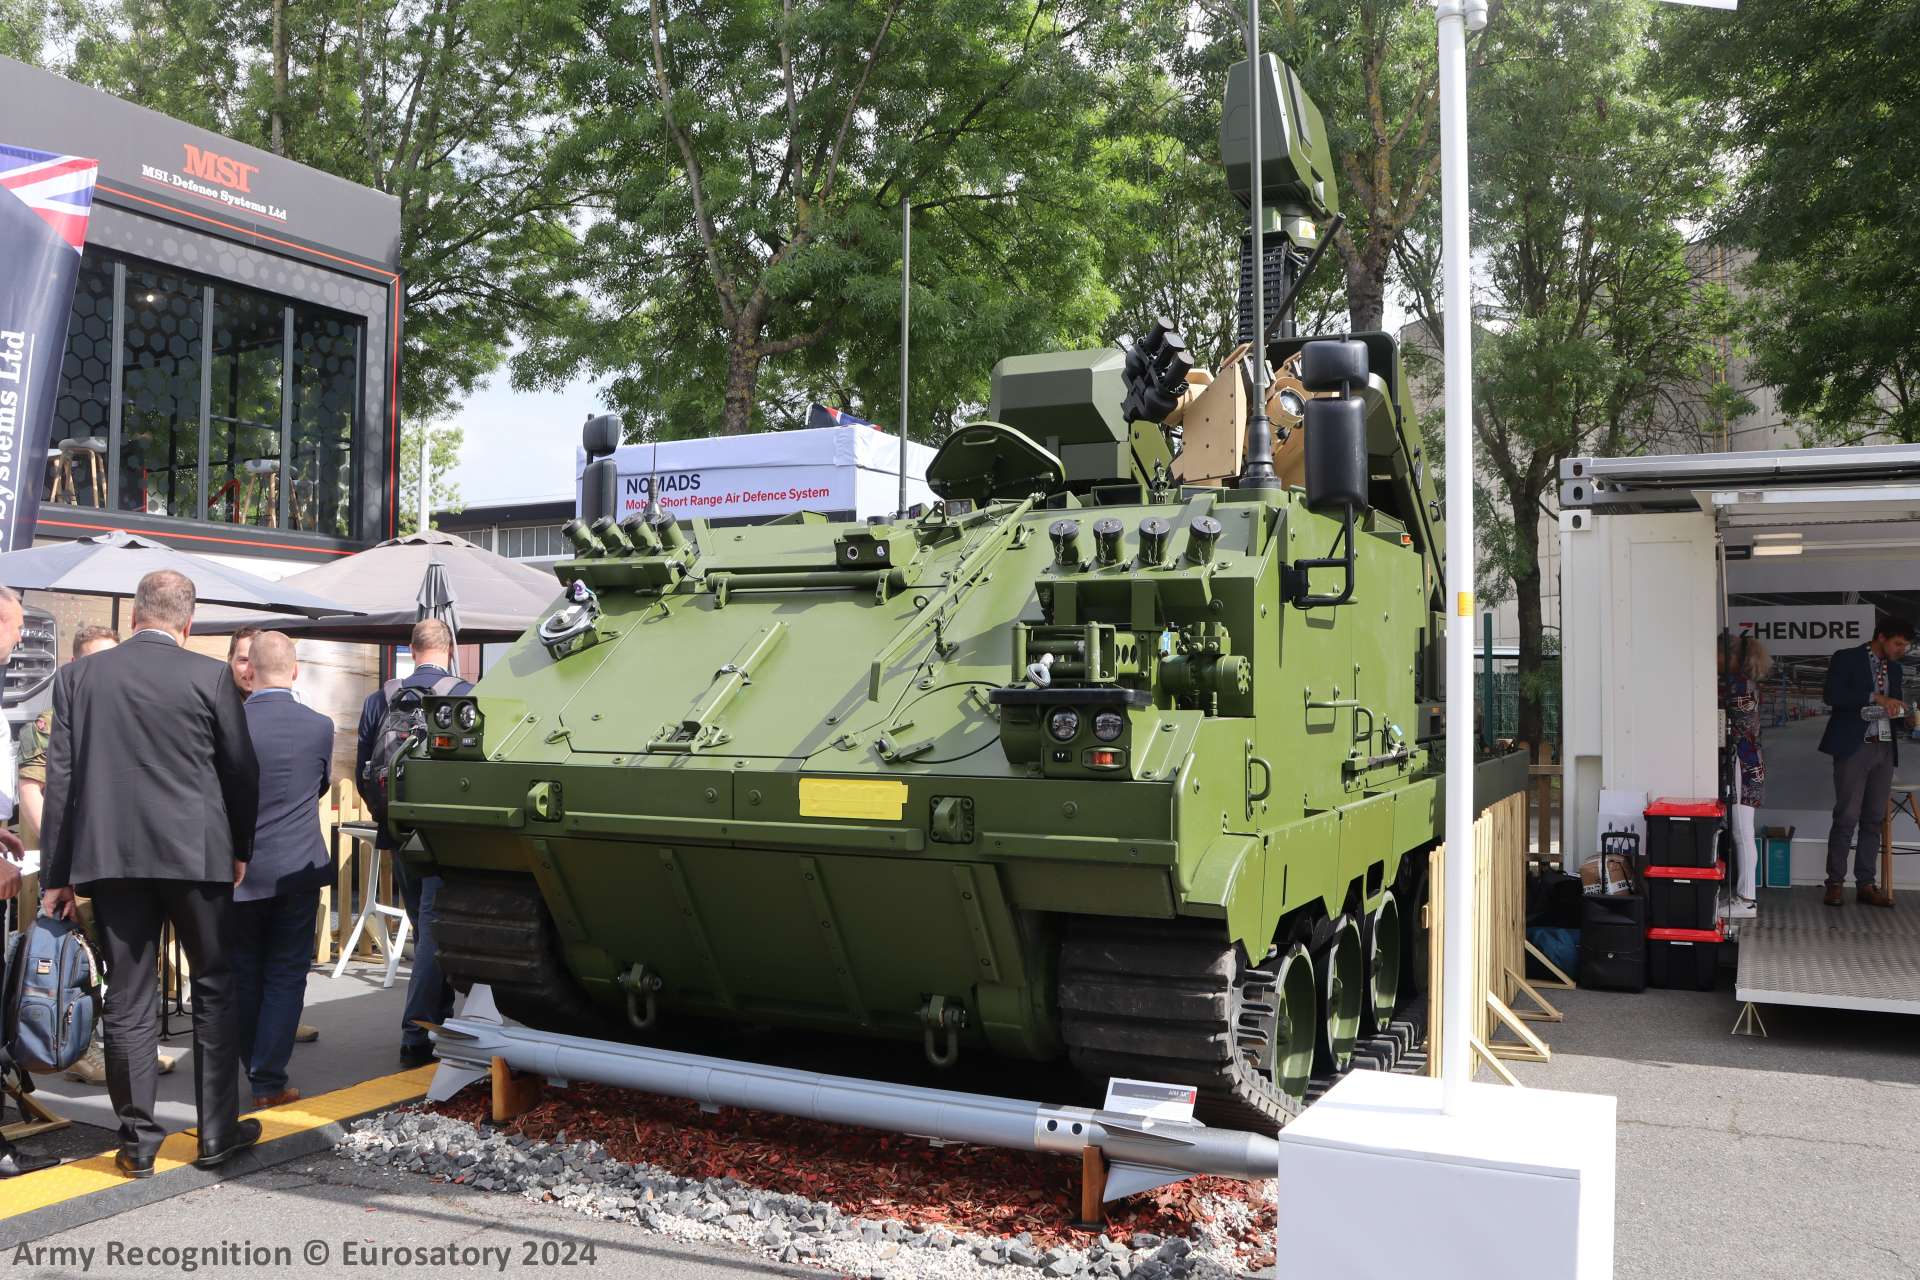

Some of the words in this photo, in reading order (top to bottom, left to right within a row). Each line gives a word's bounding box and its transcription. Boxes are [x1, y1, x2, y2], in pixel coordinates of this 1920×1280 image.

[220, 190, 267, 213] Systems
[268, 205, 288, 220] Ltd
[1, 331, 25, 384] Ltd
[660, 496, 689, 508] Short
[691, 495, 722, 507] Range
[725, 492, 740, 503] Air
[743, 489, 787, 502] Defence
[789, 487, 830, 500] System
